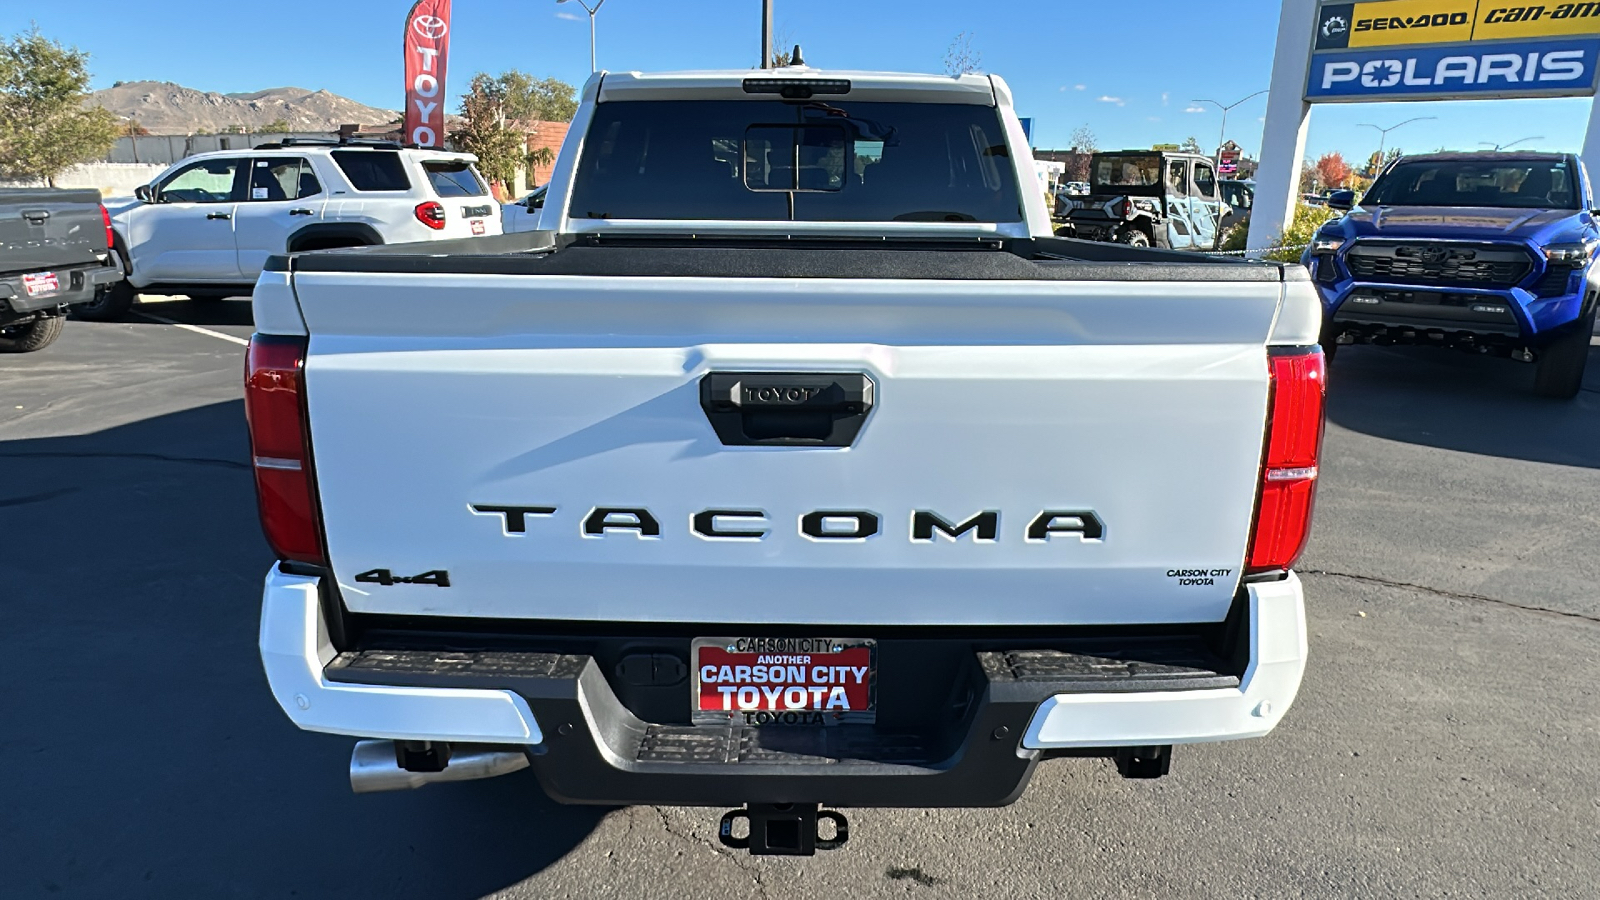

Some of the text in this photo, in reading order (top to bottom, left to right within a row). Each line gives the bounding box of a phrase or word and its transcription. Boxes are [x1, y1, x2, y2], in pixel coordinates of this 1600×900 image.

[1321, 50, 1585, 89] POLARIS
[469, 503, 1107, 544] TACOMA
[1167, 569, 1232, 577] CARSON CITY
[1178, 578, 1214, 586] TOYOTA
[736, 638, 833, 653] CARSON CITY
[757, 655, 811, 664] ANOTHER
[701, 665, 869, 684] CARSON CITY
[717, 685, 851, 710] TOYOTA
[743, 711, 826, 725] TOYOTA
